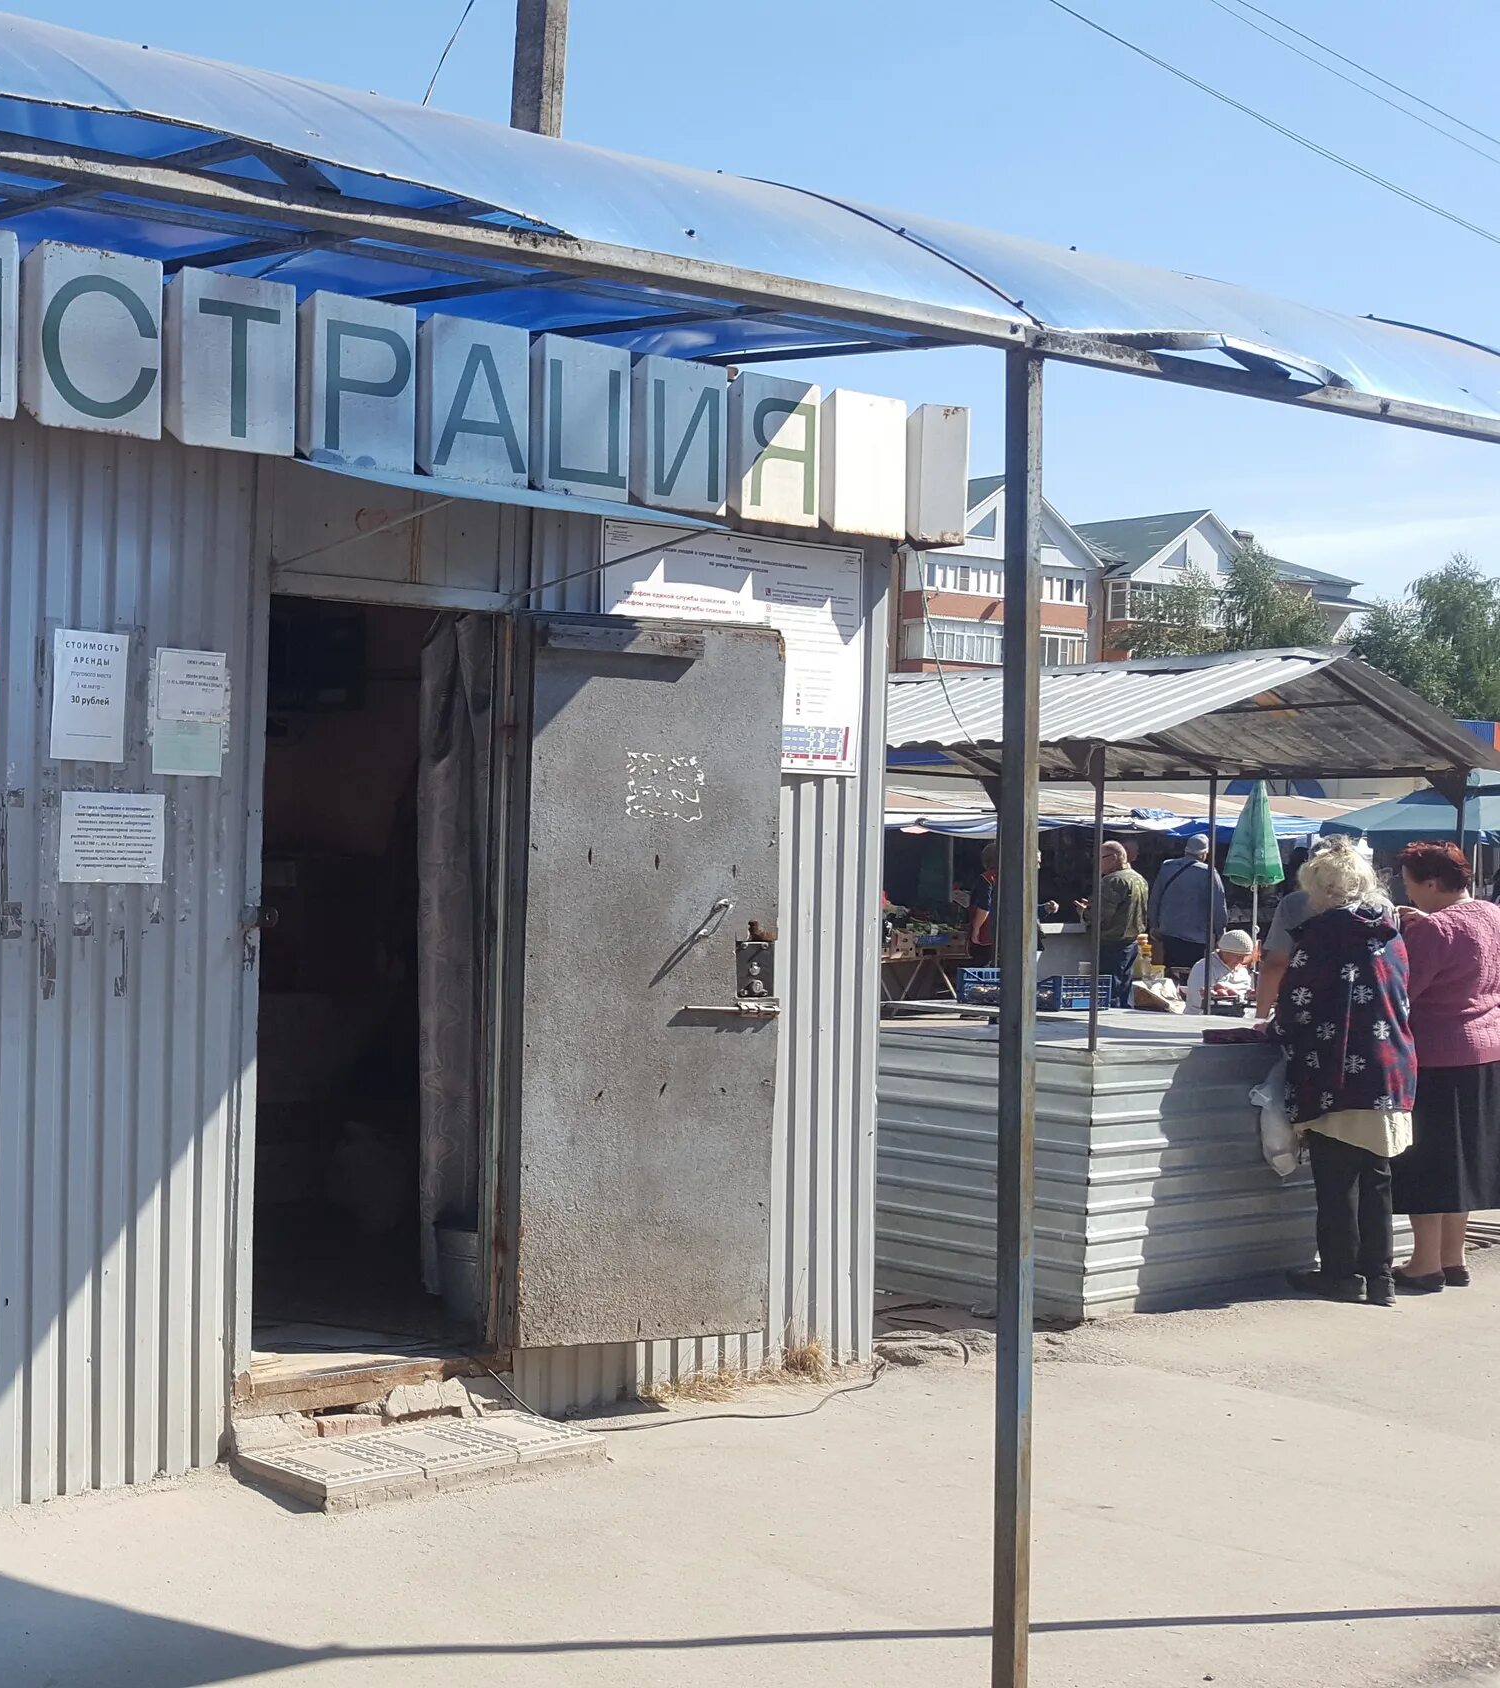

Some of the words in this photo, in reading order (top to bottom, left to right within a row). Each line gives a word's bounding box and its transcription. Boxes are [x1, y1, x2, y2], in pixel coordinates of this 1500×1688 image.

[65, 640, 120, 652] СТОИМОСТЬ
[73, 656, 110, 666] АРЕНДЫ
[70, 695, 81, 704] 30
[81, 696, 110, 706] рублей
